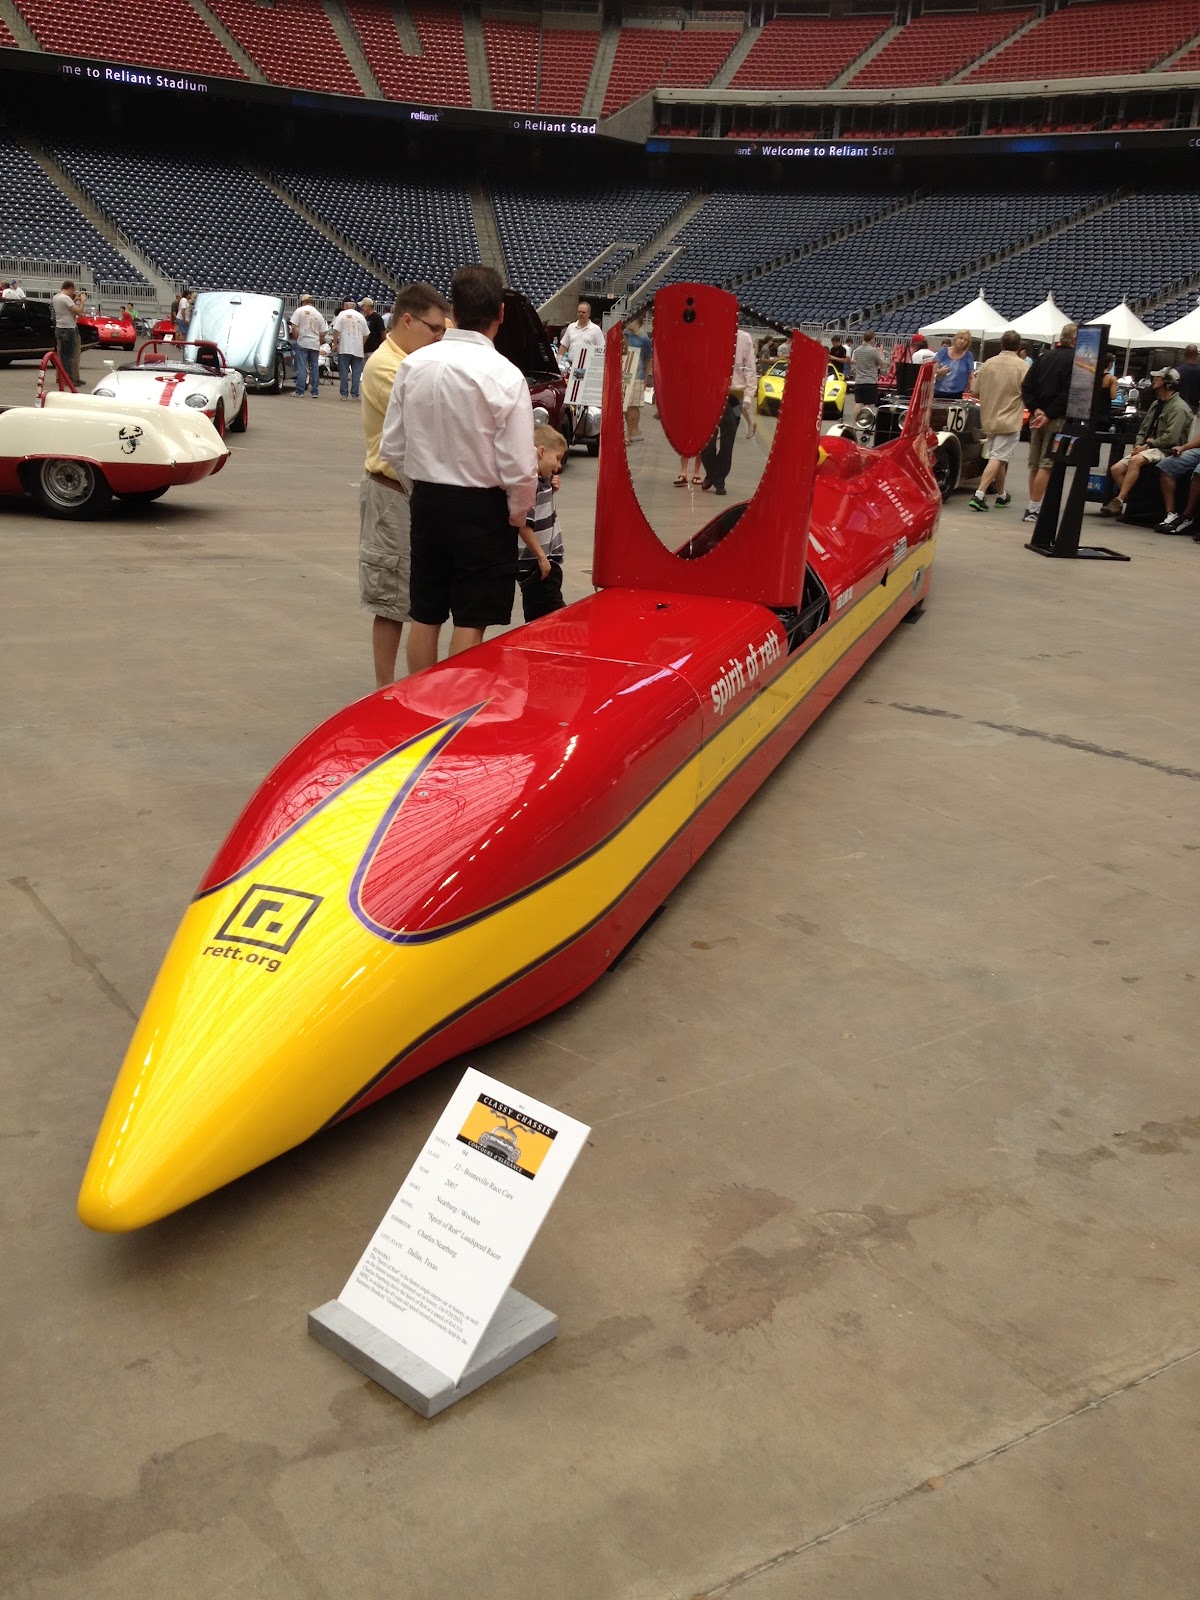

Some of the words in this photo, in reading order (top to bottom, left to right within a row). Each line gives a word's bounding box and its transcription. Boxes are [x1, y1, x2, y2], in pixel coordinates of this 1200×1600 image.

[86, 66, 100, 78] to
[105, 68, 152, 86] Reliant
[156, 76, 208, 92] Stadium
[410, 110, 438, 122] reliant
[524, 120, 566, 132] Reliant
[570, 122, 596, 134] Stad
[762, 146, 810, 156] Welcome
[814, 146, 825, 156] to
[829, 146, 868, 156] Reliant
[872, 146, 895, 156] Stad
[950, 408, 964, 430] 76
[710, 658, 746, 715] spirit
[746, 643, 758, 682] of
[759, 629, 780, 670] rett
[202, 945, 282, 972] rett.org
[482, 1096, 513, 1116] CLASSY
[515, 1112, 551, 1135] CHASSIS
[467, 1140, 493, 1157] CONCOURS
[444, 1178, 458, 1190] 2007
[463, 1167, 490, 1186] Bonneville
[488, 1181, 502, 1193] Race
[500, 1188, 514, 1200] Cars
[434, 1195, 458, 1213] Nearburg
[459, 1209, 481, 1226] Wooden
[416, 1228, 435, 1243] Charles
[433, 1239, 458, 1258] Nearburg
[441, 1220, 448, 1228] of
[459, 1232, 487, 1253] Landspeed
[486, 1247, 502, 1260] Racer
[406, 1247, 424, 1262] Dallas,
[423, 1257, 438, 1270] Texas
